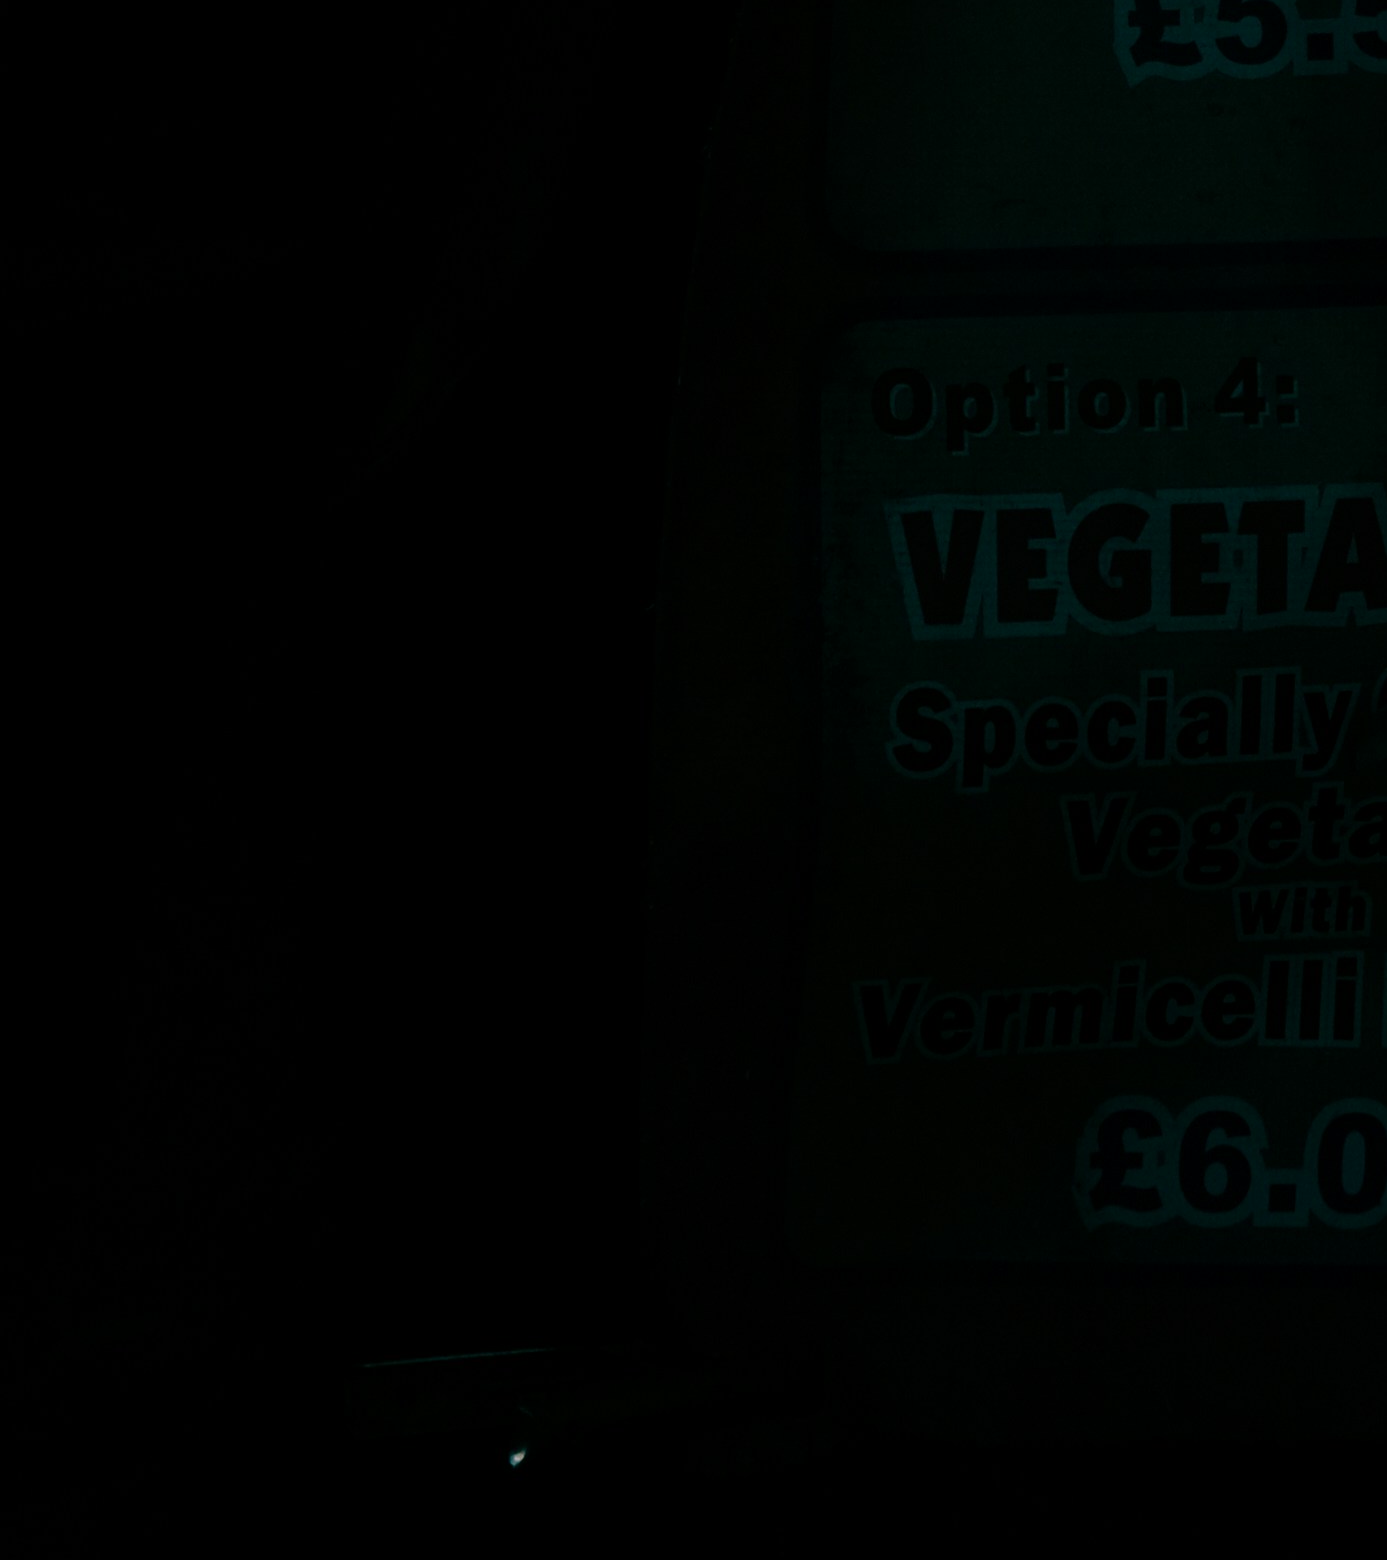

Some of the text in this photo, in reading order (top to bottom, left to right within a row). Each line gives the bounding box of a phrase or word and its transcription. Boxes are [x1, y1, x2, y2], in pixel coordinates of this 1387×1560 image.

[869, 354, 1301, 455] Option 4:
[887, 669, 1356, 786] Specially
[1235, 885, 1369, 937] With
[856, 954, 1362, 1062] Vermicelli
